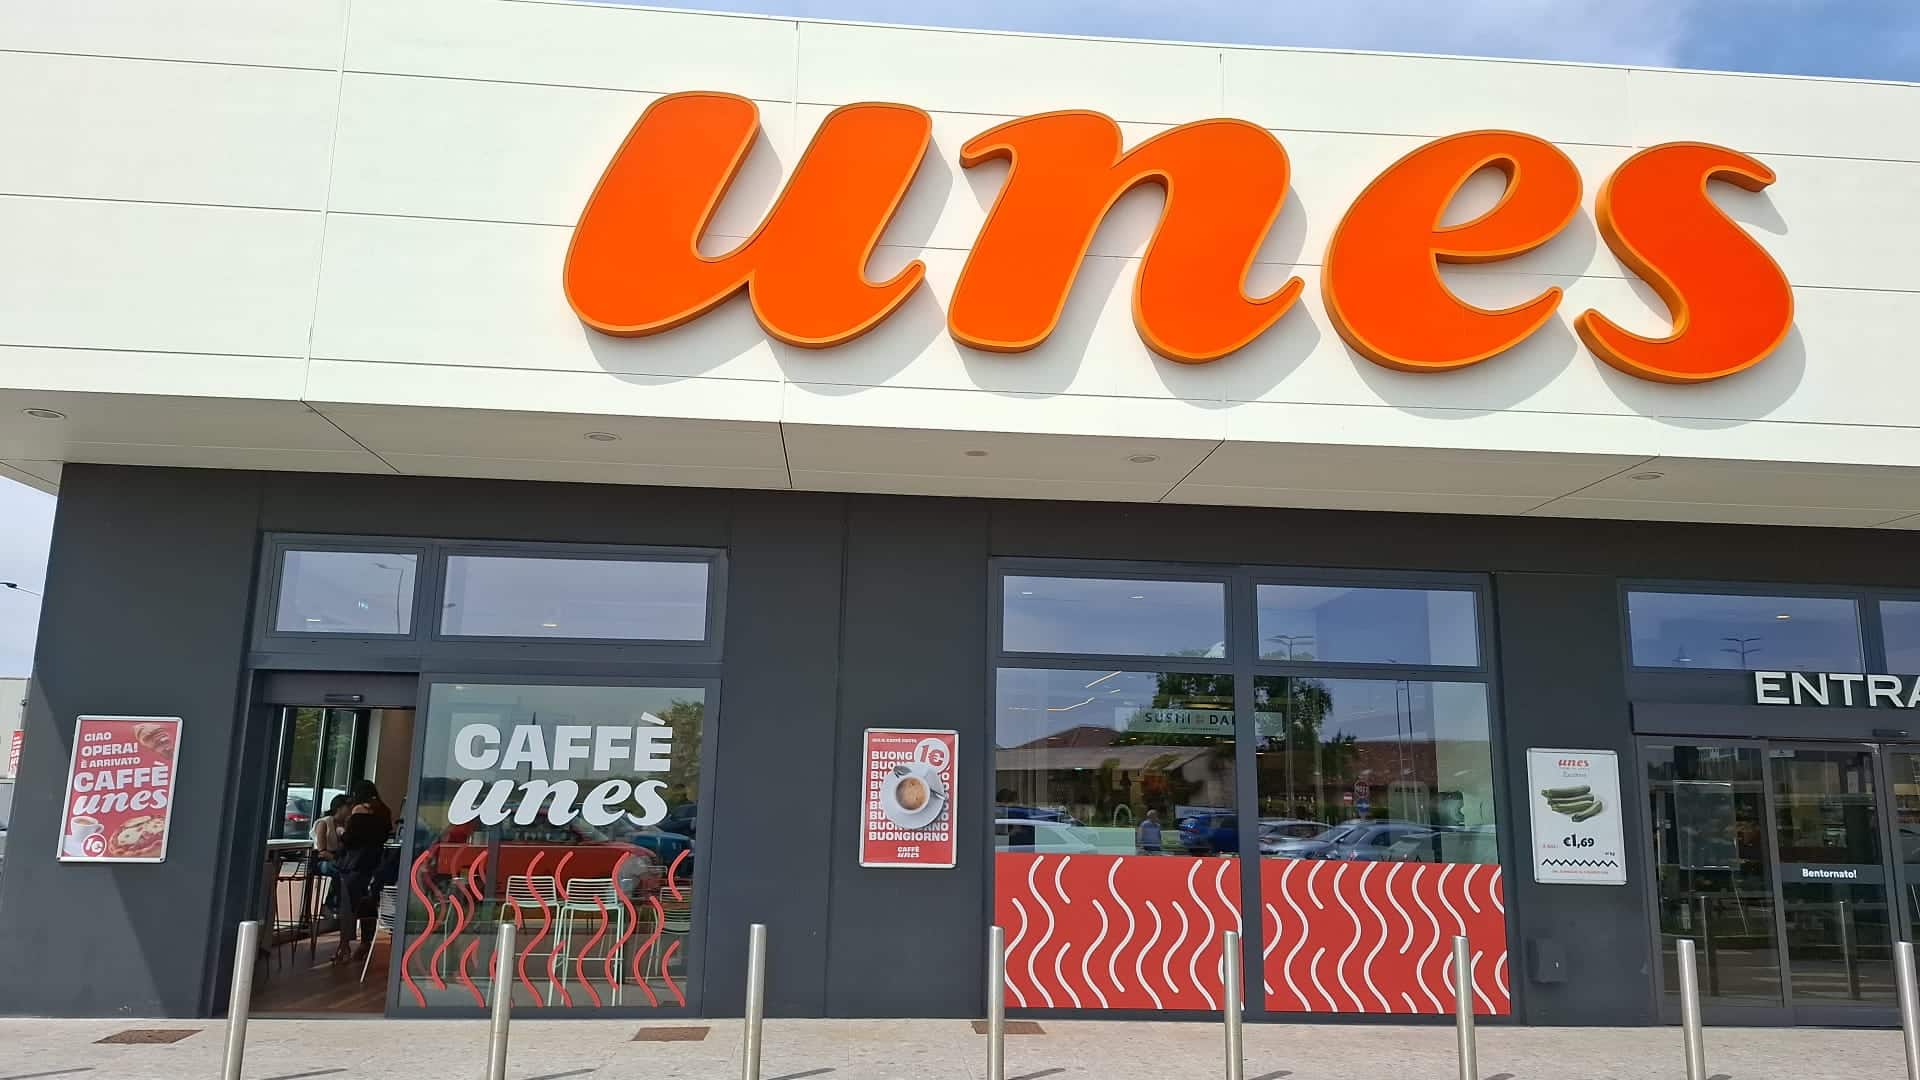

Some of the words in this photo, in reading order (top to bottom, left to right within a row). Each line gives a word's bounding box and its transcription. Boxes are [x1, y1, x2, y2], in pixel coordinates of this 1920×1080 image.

[563, 91, 1794, 384] unes
[84, 731, 112, 742] CIAO
[454, 712, 674, 772] CAFFÈ
[81, 742, 138, 757] OPERA!
[872, 751, 913, 760] BUONG
[920, 744, 945, 767] 1€
[80, 759, 88, 768] È
[89, 756, 140, 768] ARRIVATO
[73, 761, 168, 792] CAFFÈ
[72, 789, 168, 815] unes
[447, 778, 669, 827] unes
[869, 832, 949, 841] BUONGIORNO
[1563, 833, 1595, 849] €1,69
[1802, 868, 1857, 879] Bentornato!
